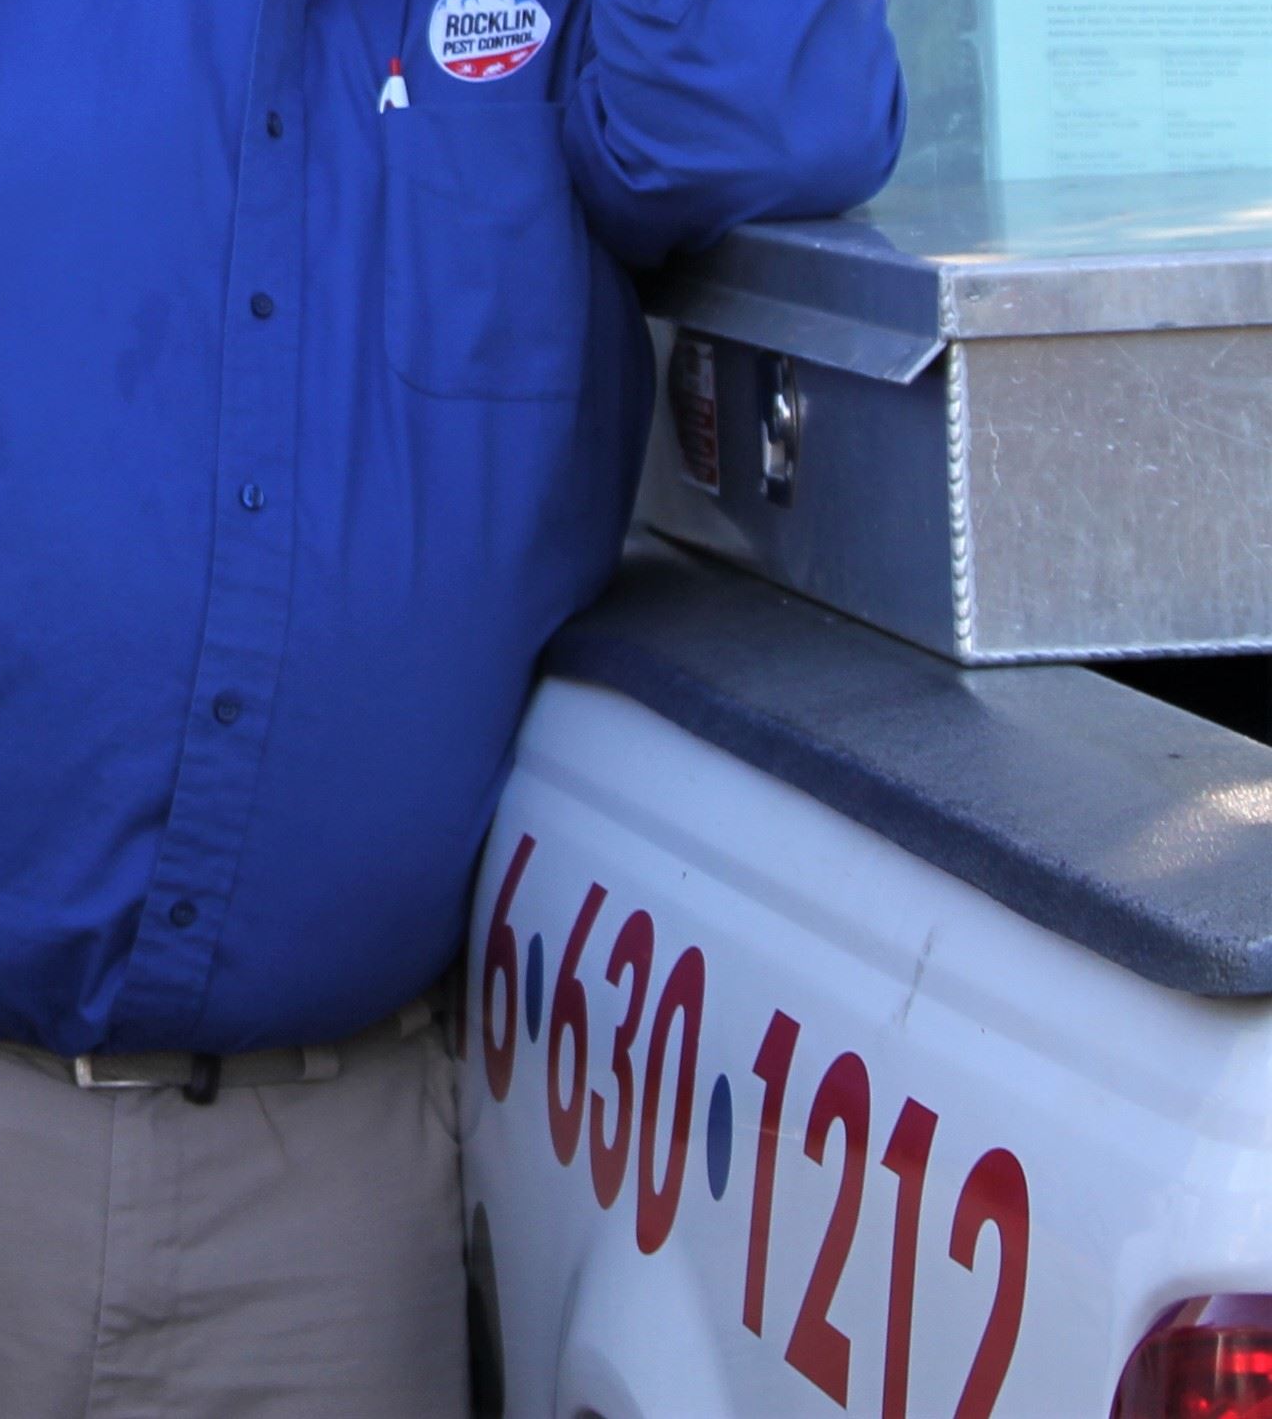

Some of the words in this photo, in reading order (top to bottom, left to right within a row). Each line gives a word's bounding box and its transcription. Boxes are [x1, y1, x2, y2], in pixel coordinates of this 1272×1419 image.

[445, 8, 536, 38] ROCKLIN
[443, 39, 476, 56] PEST
[478, 31, 533, 51] CONTROL
